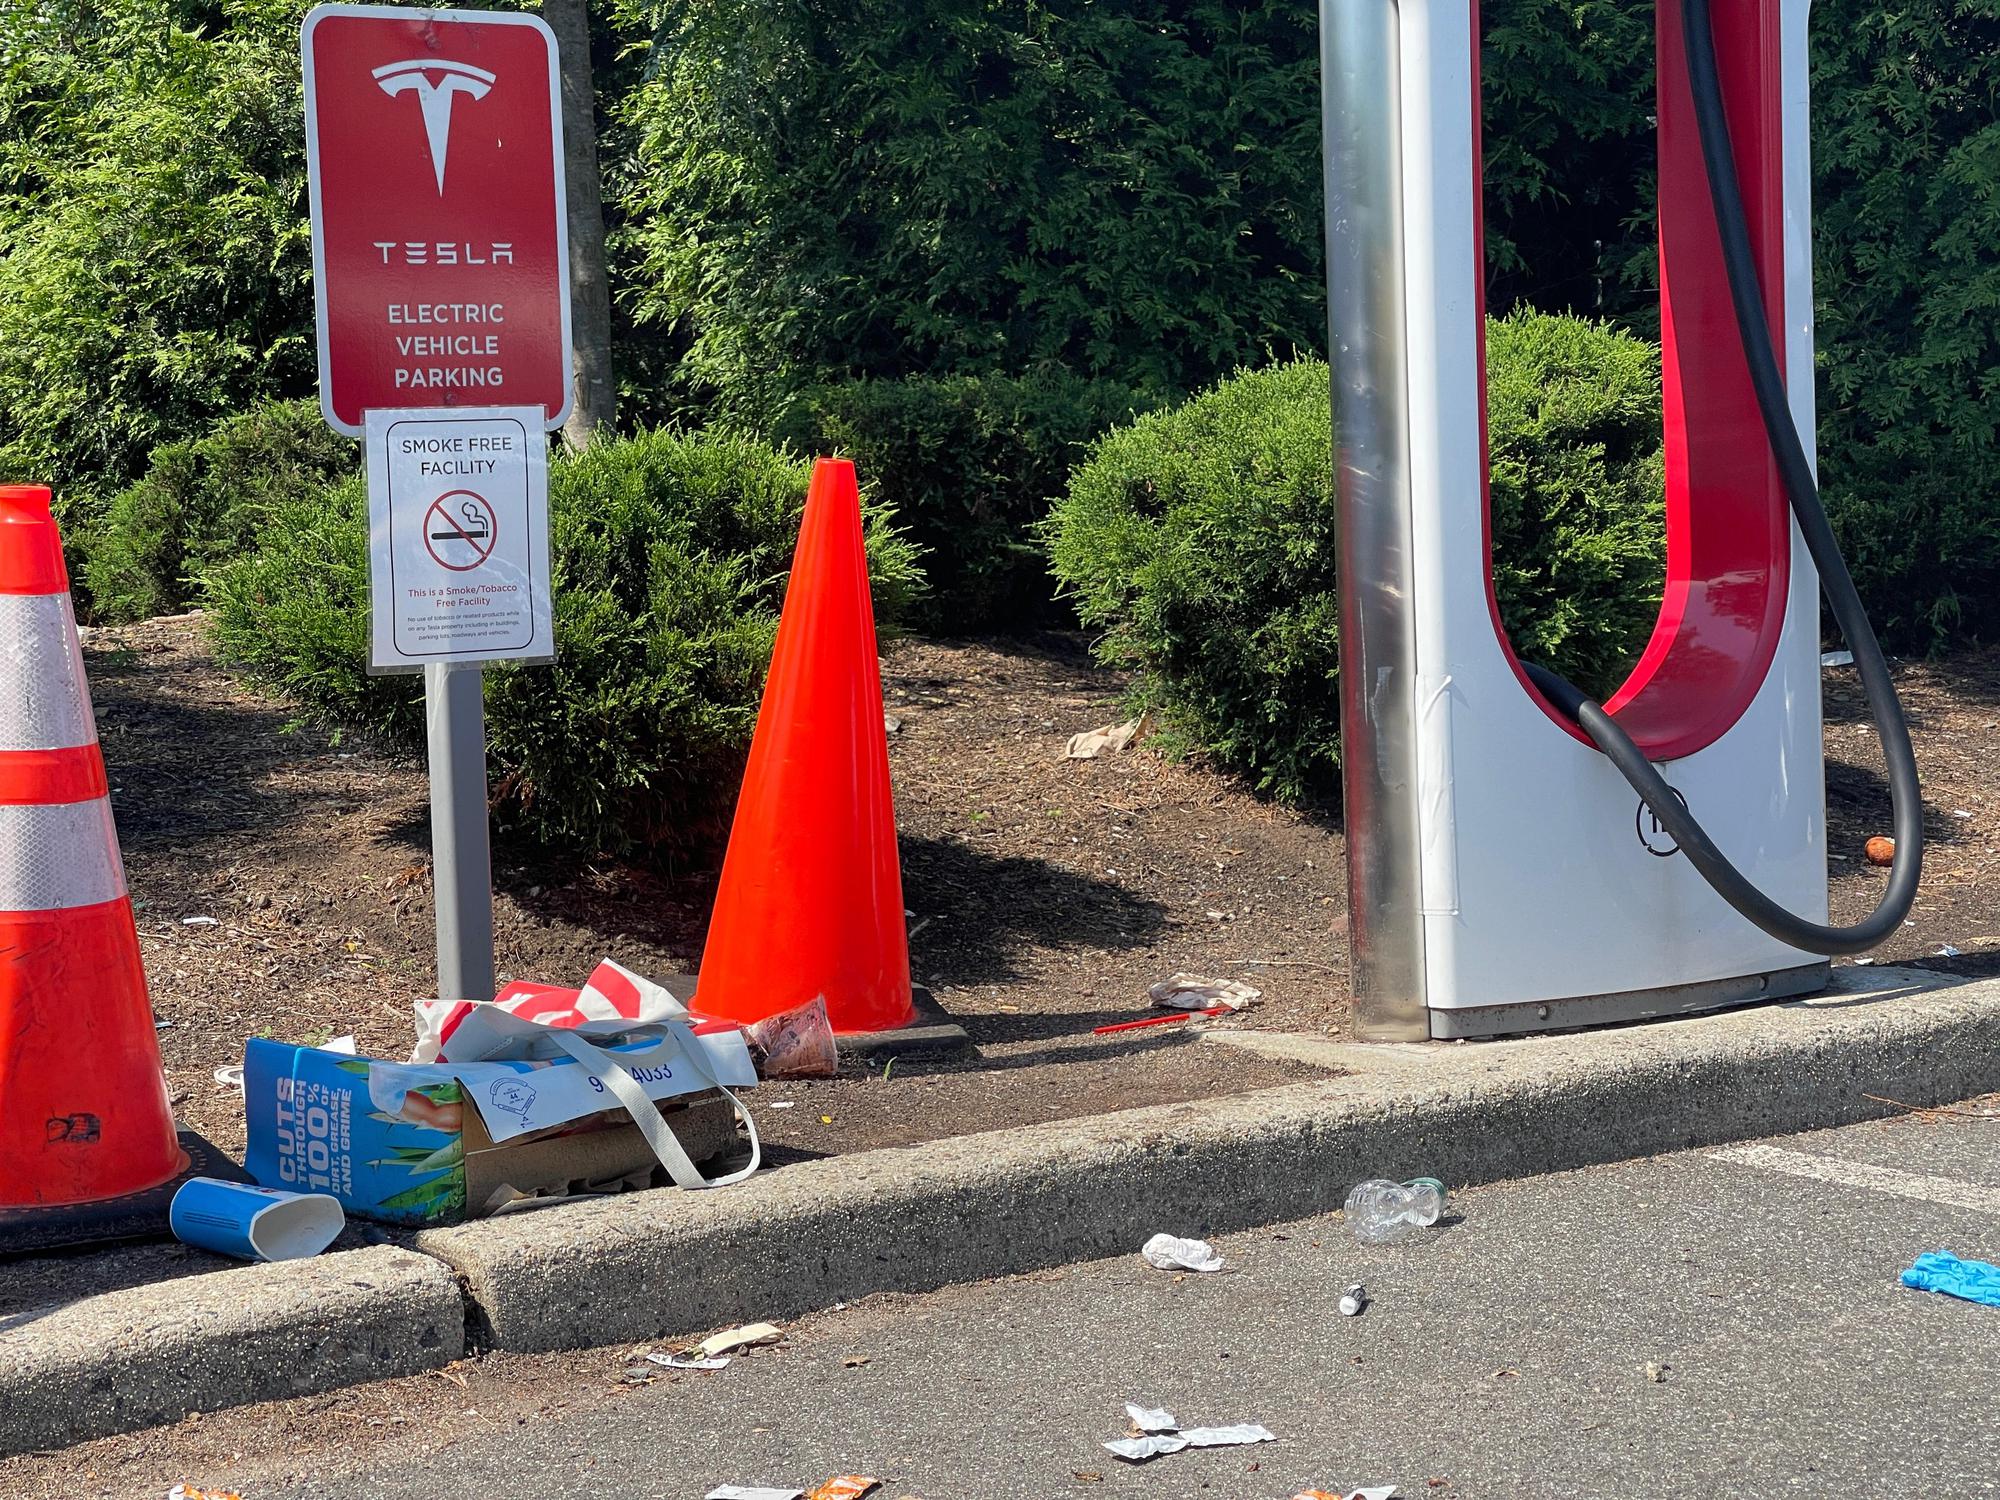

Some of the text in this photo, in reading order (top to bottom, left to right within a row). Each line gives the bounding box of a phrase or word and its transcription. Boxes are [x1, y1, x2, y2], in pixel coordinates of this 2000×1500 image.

[373, 242, 513, 264] TESLA
[388, 304, 504, 324] ELECTRIC
[396, 336, 499, 356] VEHICLE
[395, 367, 503, 388] PARKING
[402, 437, 512, 454] SMOKE FREE
[421, 460, 496, 475] FACILITY
[408, 588, 427, 597] This
[429, 588, 436, 596] is
[446, 584, 518, 595] Smoke/Tobacco
[436, 597, 491, 608] Free Facility
[320, 1084, 329, 1106] OF
[276, 1077, 296, 1183] CUTS
[330, 1087, 342, 1153] GREASE,
[294, 1080, 307, 1185] THROUGH
[340, 1088, 352, 1197] AND GRIME
